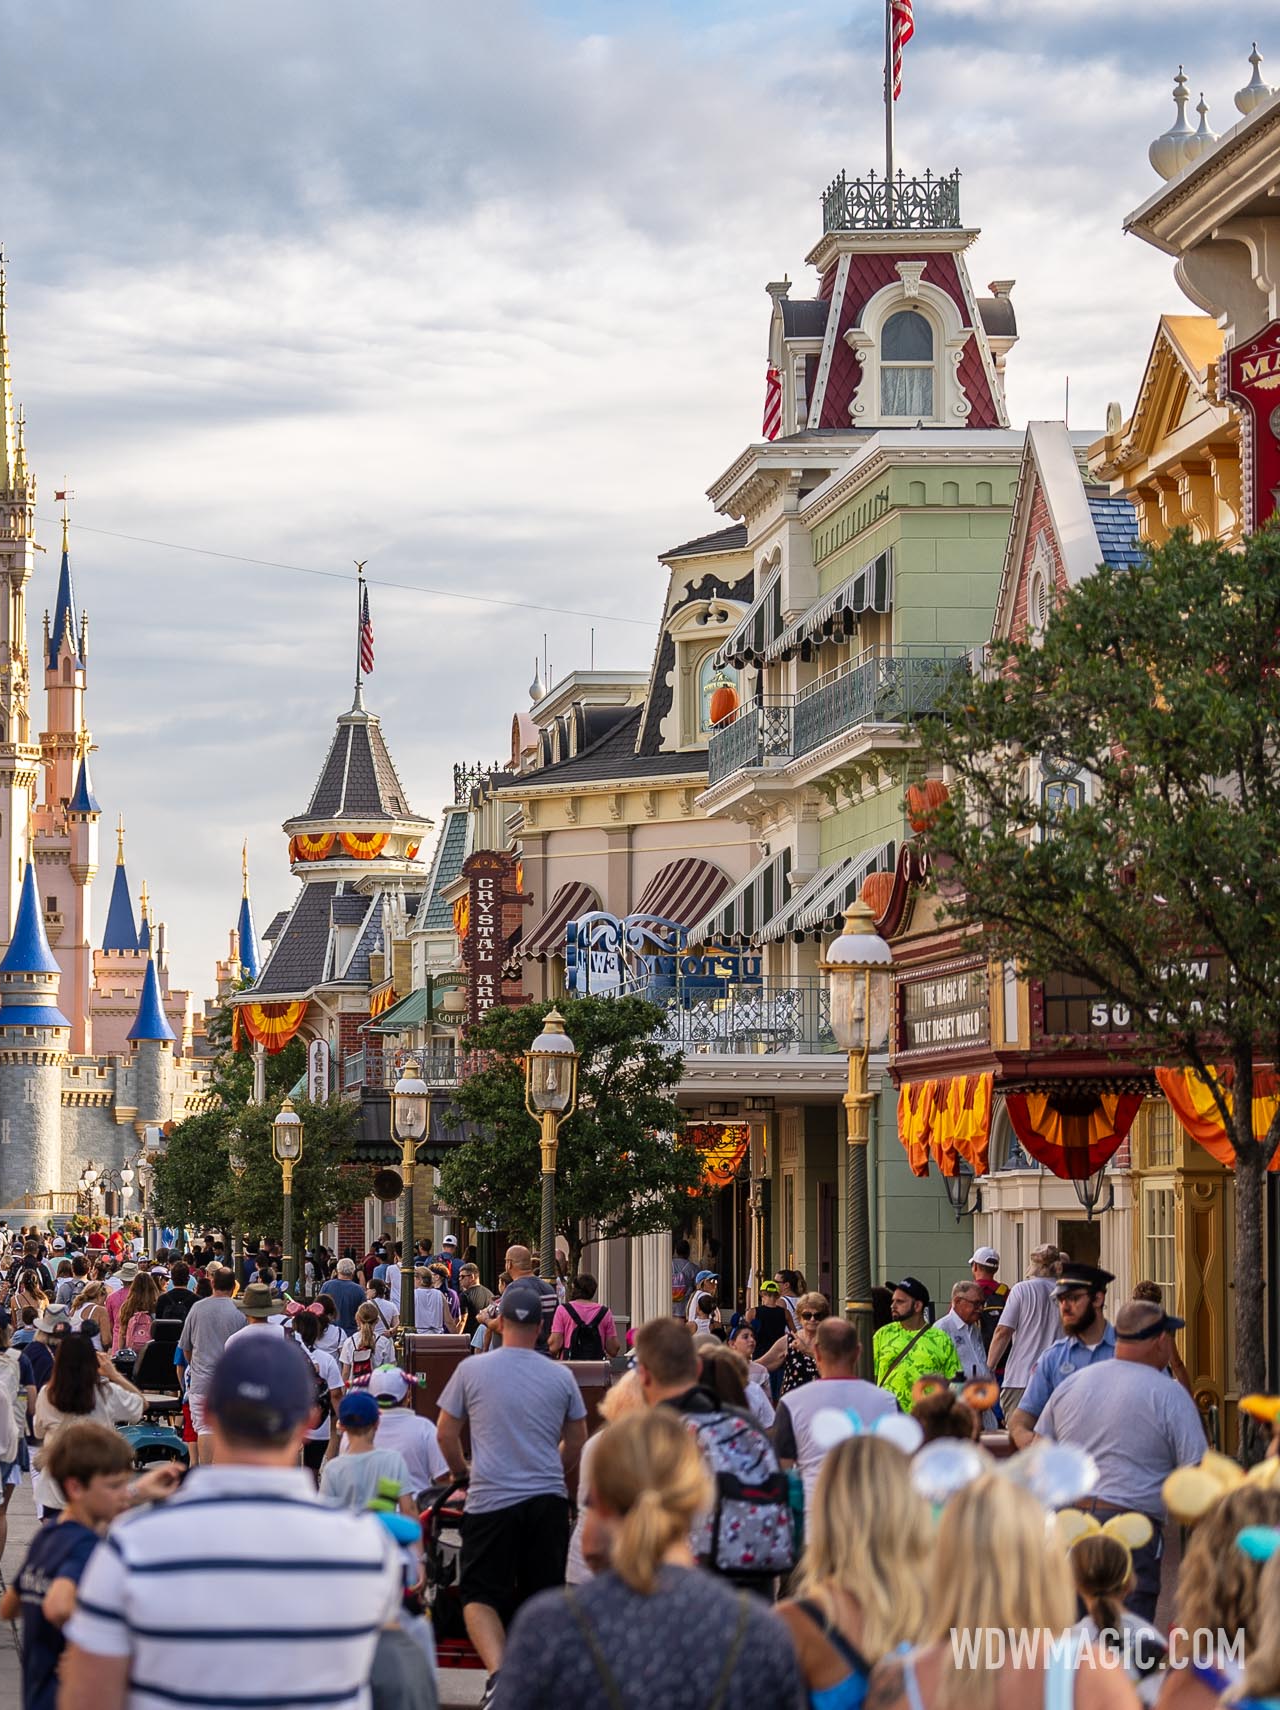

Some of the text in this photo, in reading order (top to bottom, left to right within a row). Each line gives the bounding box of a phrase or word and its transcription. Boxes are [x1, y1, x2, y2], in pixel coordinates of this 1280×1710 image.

[477, 878, 494, 961] CRYSTAL
[924, 978, 967, 1008] THE MAGIC OF
[914, 1011, 980, 1043] WALT DISNEY WORLD
[1091, 1003, 1130, 1026] 50
